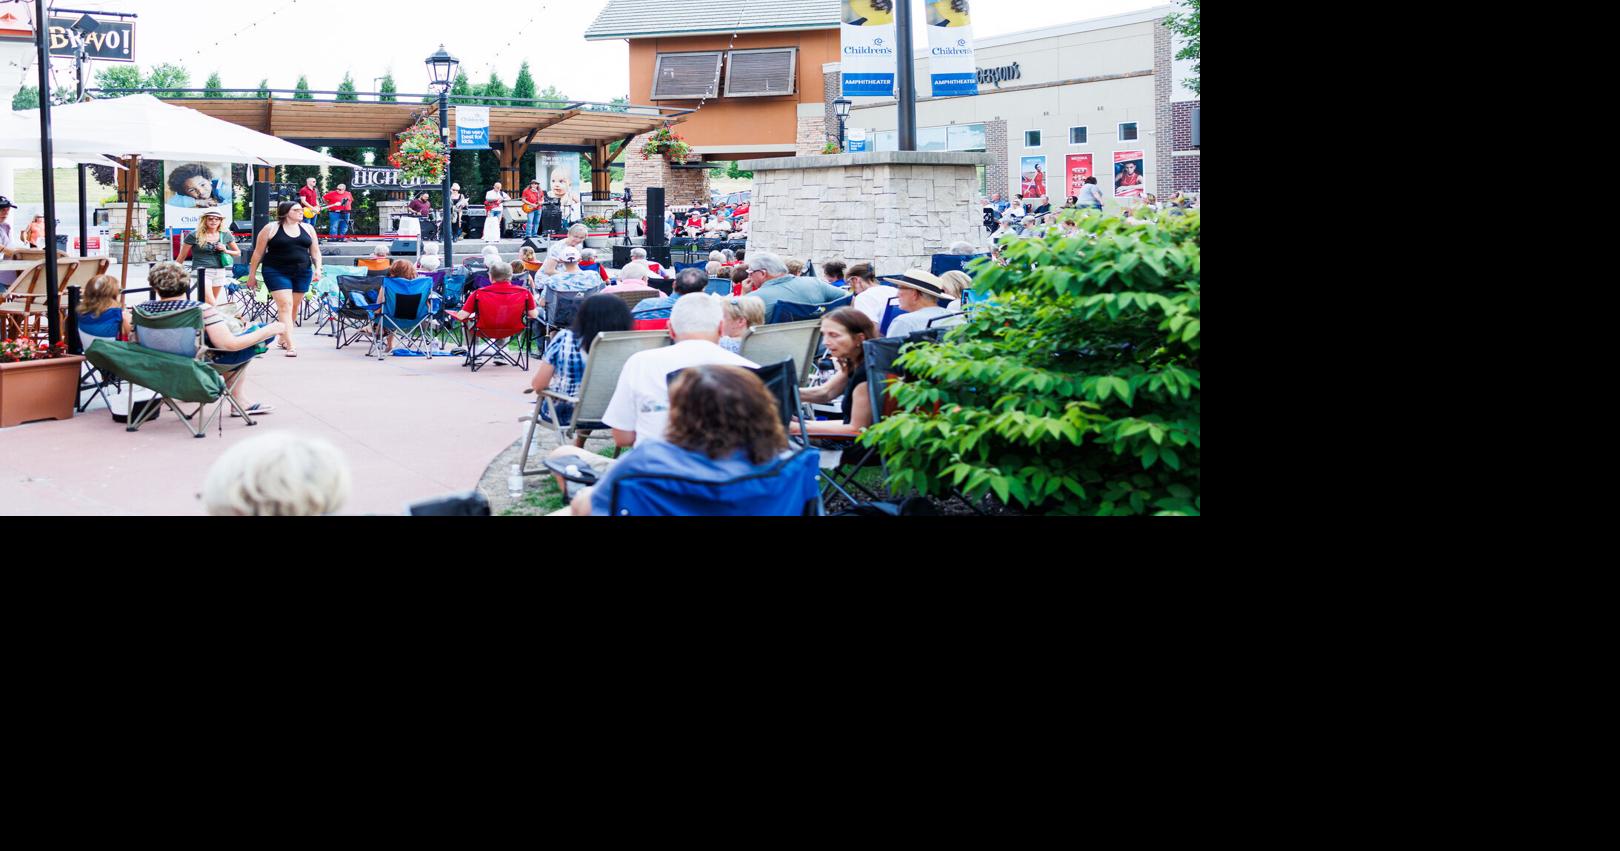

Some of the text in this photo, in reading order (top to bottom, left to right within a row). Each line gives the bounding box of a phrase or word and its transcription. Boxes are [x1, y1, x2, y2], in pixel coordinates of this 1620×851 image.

[48, 26, 130, 55] BRAVO!
[844, 46, 892, 55] Children's
[352, 170, 398, 186] HIGH
